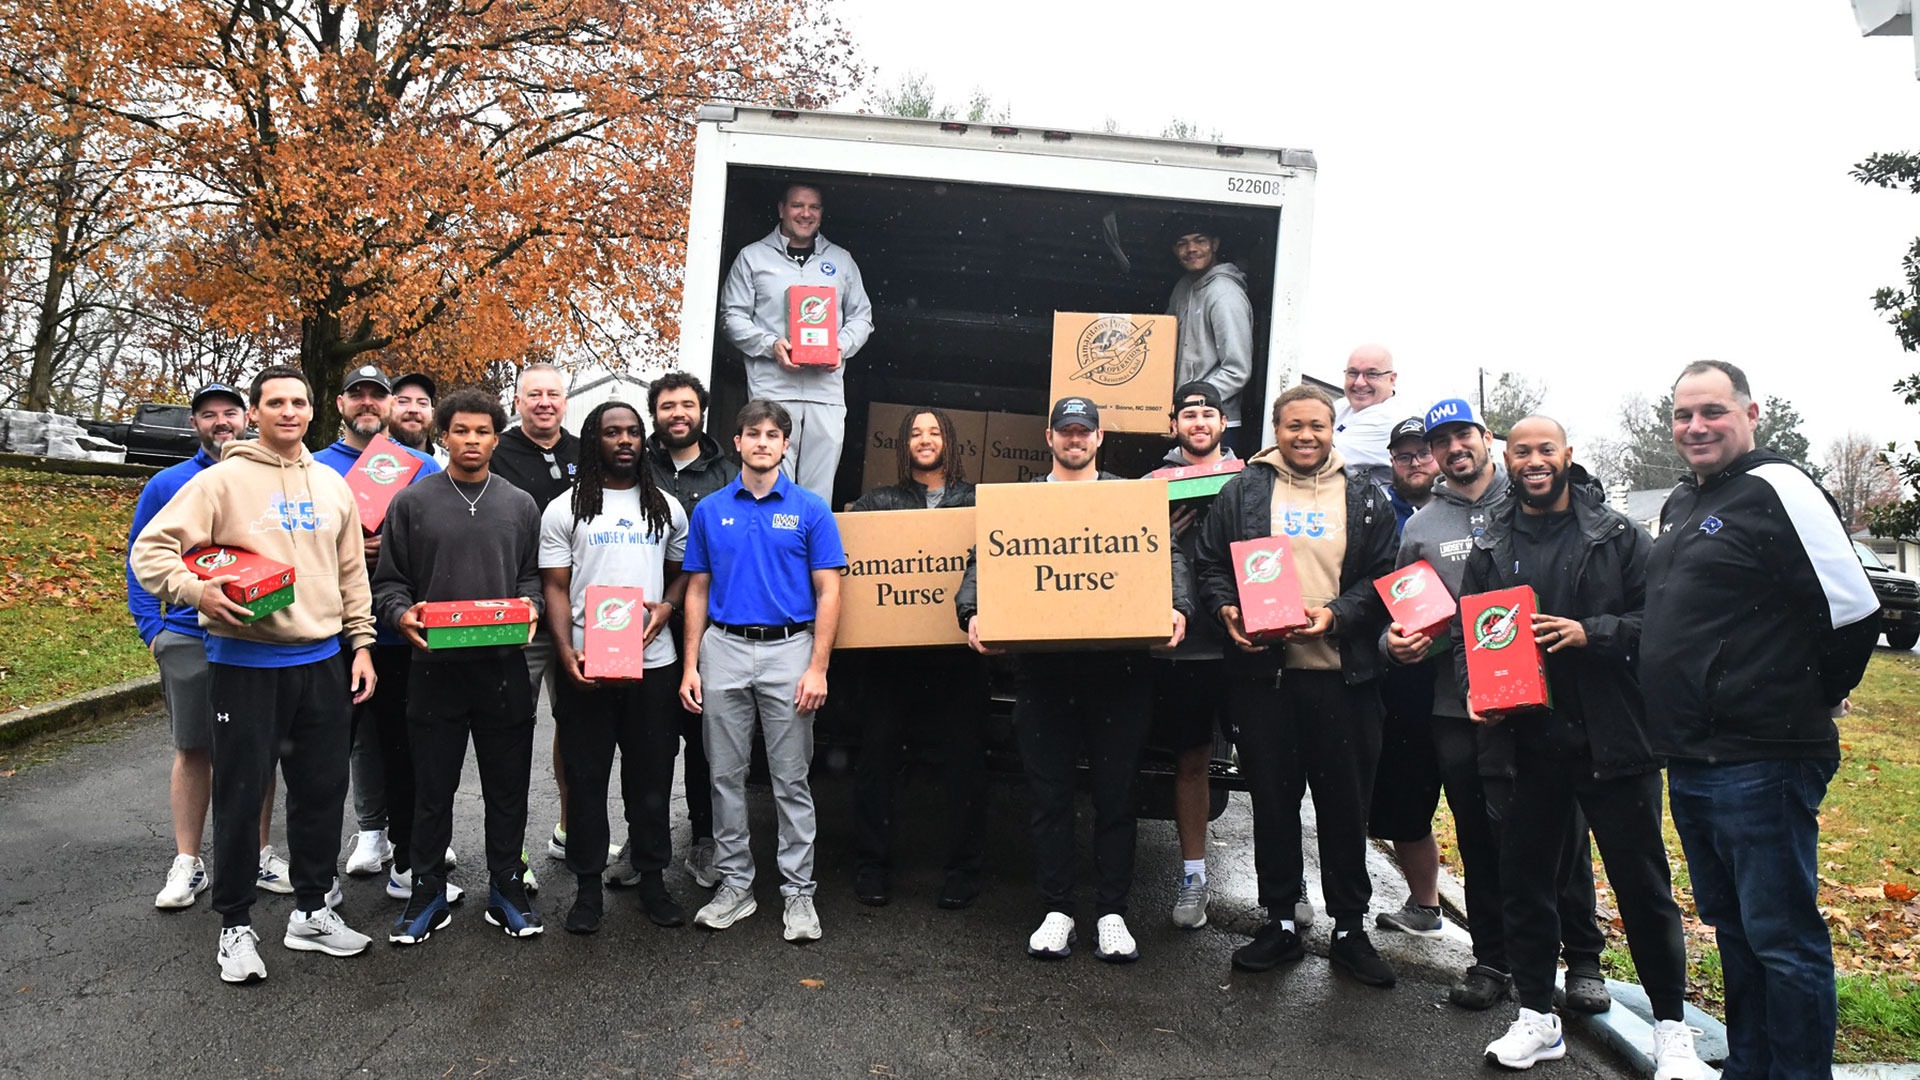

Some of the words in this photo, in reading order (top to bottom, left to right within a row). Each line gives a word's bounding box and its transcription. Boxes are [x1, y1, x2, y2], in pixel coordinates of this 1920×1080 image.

[1228, 177, 1280, 195] 522608
[1106, 347, 1142, 373] OPERATION
[1430, 403, 1458, 423] LWU
[279, 502, 320, 530] 55
[1284, 511, 1325, 537] 55
[588, 531, 624, 546] LINDSEY
[988, 526, 1159, 557] Samaritan's
[1034, 564, 1115, 592] Purse
[876, 583, 945, 607] Purse
